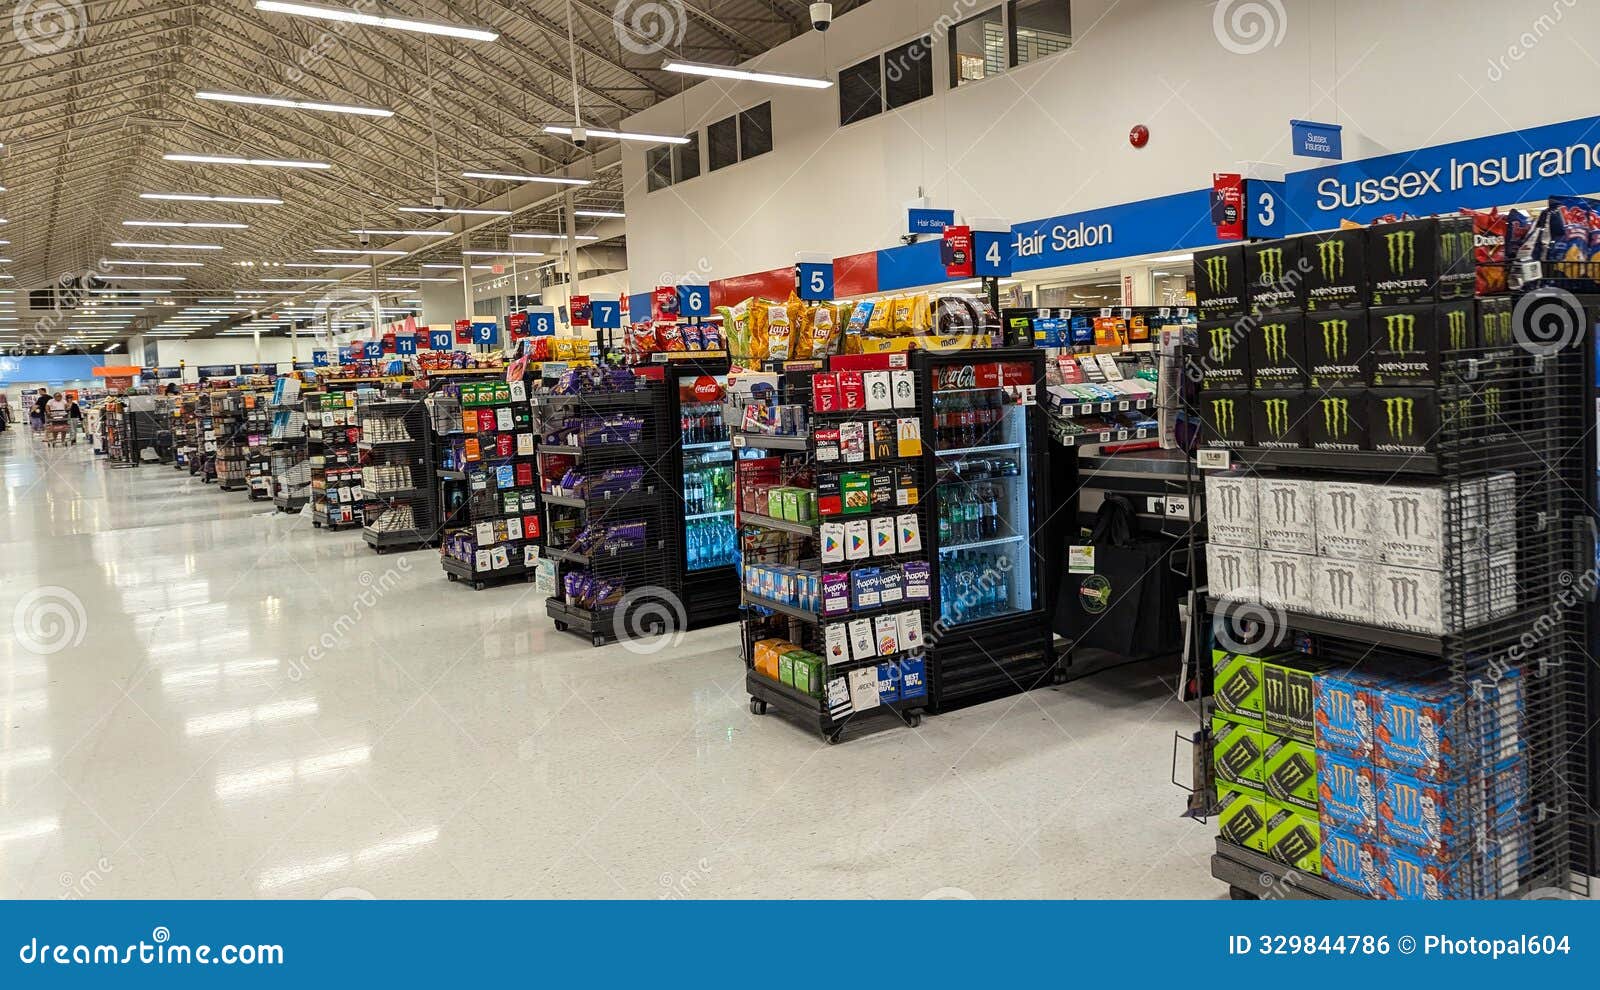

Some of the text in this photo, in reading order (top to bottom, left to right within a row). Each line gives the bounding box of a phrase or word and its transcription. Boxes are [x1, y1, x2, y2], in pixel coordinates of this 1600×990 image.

[1306, 132, 1328, 144] Sussex
[1304, 141, 1331, 154] Insurance
[1316, 166, 1443, 212] Sussex
[1258, 192, 1275, 226] 3
[917, 219, 946, 227] Hair Salon
[1051, 222, 1113, 251] Salon
[985, 241, 1001, 267] 4
[810, 271, 824, 293] 5
[1376, 279, 1428, 290] MONSTER
[1310, 285, 1357, 296] MONSTER
[689, 292, 702, 311] 6
[1201, 297, 1239, 307] MONSTER
[601, 306, 612, 322] 7
[537, 317, 548, 332] 8
[481, 327, 490, 340] 9
[814, 328, 830, 340] Lay
[400, 340, 412, 350] 11
[433, 334, 449, 346] 10
[366, 344, 380, 355] 12
[1256, 367, 1299, 376] MONSTER
[1313, 364, 1361, 374] MONSTER
[1378, 361, 1430, 371] MONSTER
[1205, 368, 1243, 377] MONSTER
[1314, 442, 1360, 451] MONSTER
[1376, 443, 1426, 453] MONSTER
[1213, 525, 1251, 534] MONSTER
[1265, 529, 1308, 539] MONSTER
[1323, 535, 1369, 546] MONSTER
[1382, 541, 1433, 553] MONSTER
[878, 572, 901, 585] happy
[905, 571, 929, 580] happy
[823, 582, 848, 593] happy
[855, 576, 879, 589] happy
[904, 672, 919, 681] BEST
[879, 678, 893, 687] BEST
[905, 679, 918, 687] BUY
[1328, 725, 1357, 737] PUNCH
[1390, 741, 1421, 755] PUNCH
[1331, 799, 1359, 813] PUNCH
